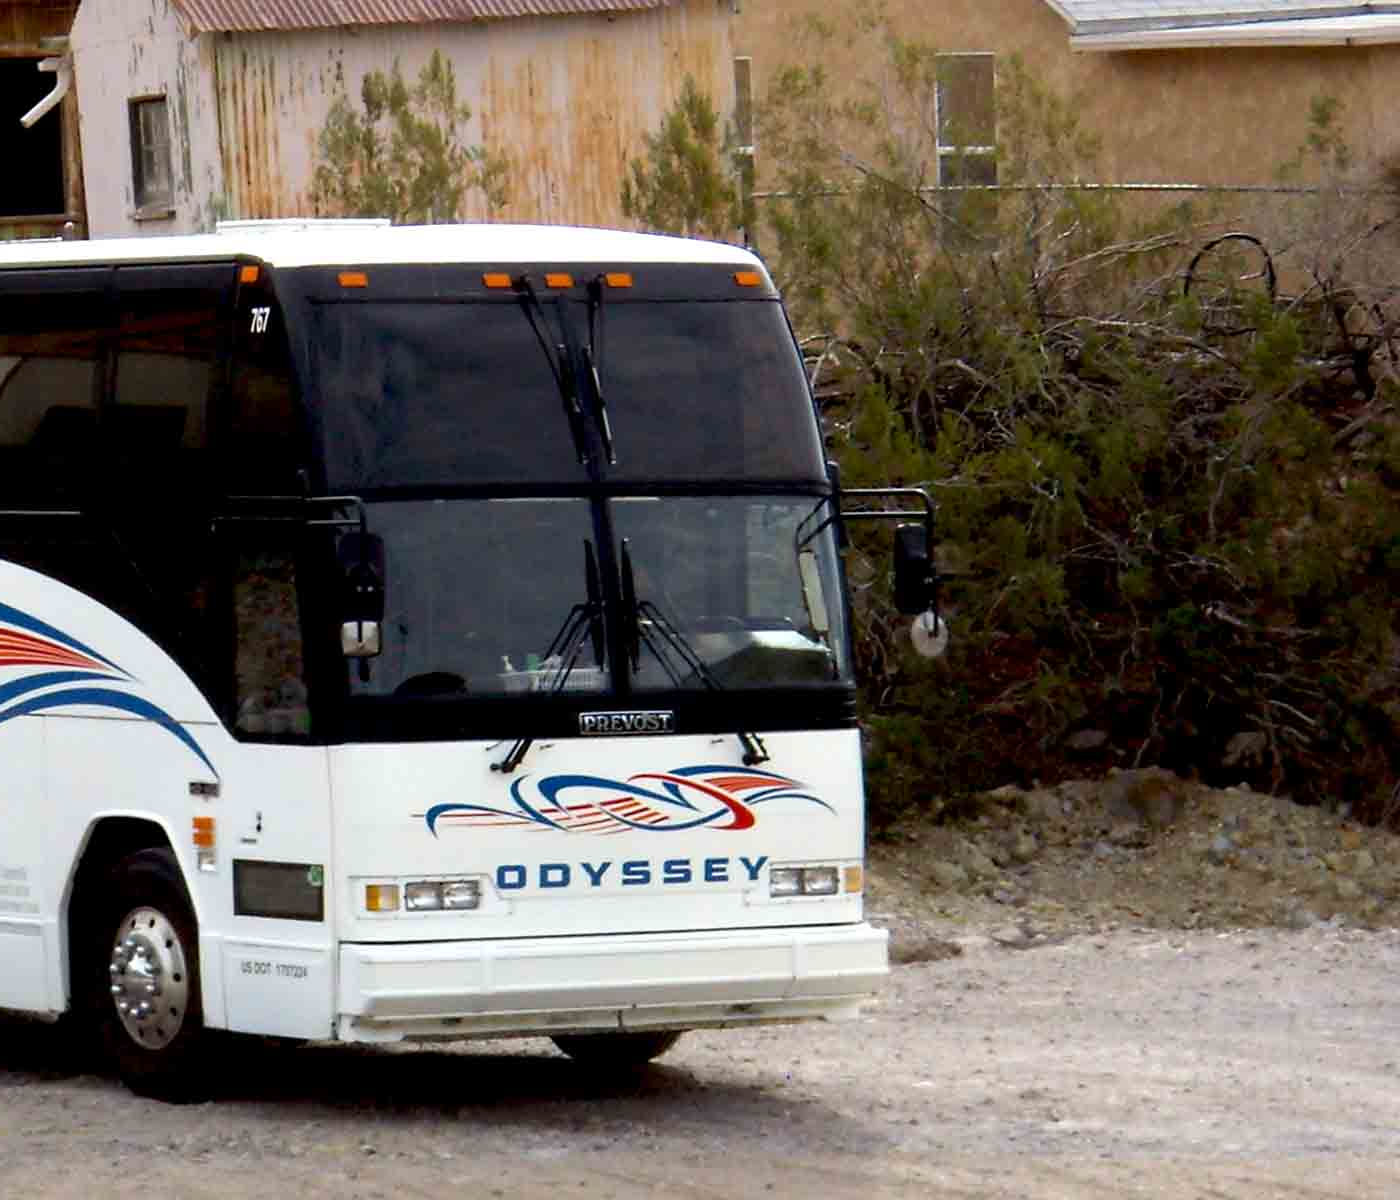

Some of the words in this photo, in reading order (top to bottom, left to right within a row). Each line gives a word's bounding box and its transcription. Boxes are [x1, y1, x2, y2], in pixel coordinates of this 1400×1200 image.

[251, 307, 270, 333] 767
[584, 714, 669, 731] PREVOST
[496, 856, 768, 889] ODYSSEY
[241, 961, 253, 976] US
[255, 961, 271, 977] DOT
